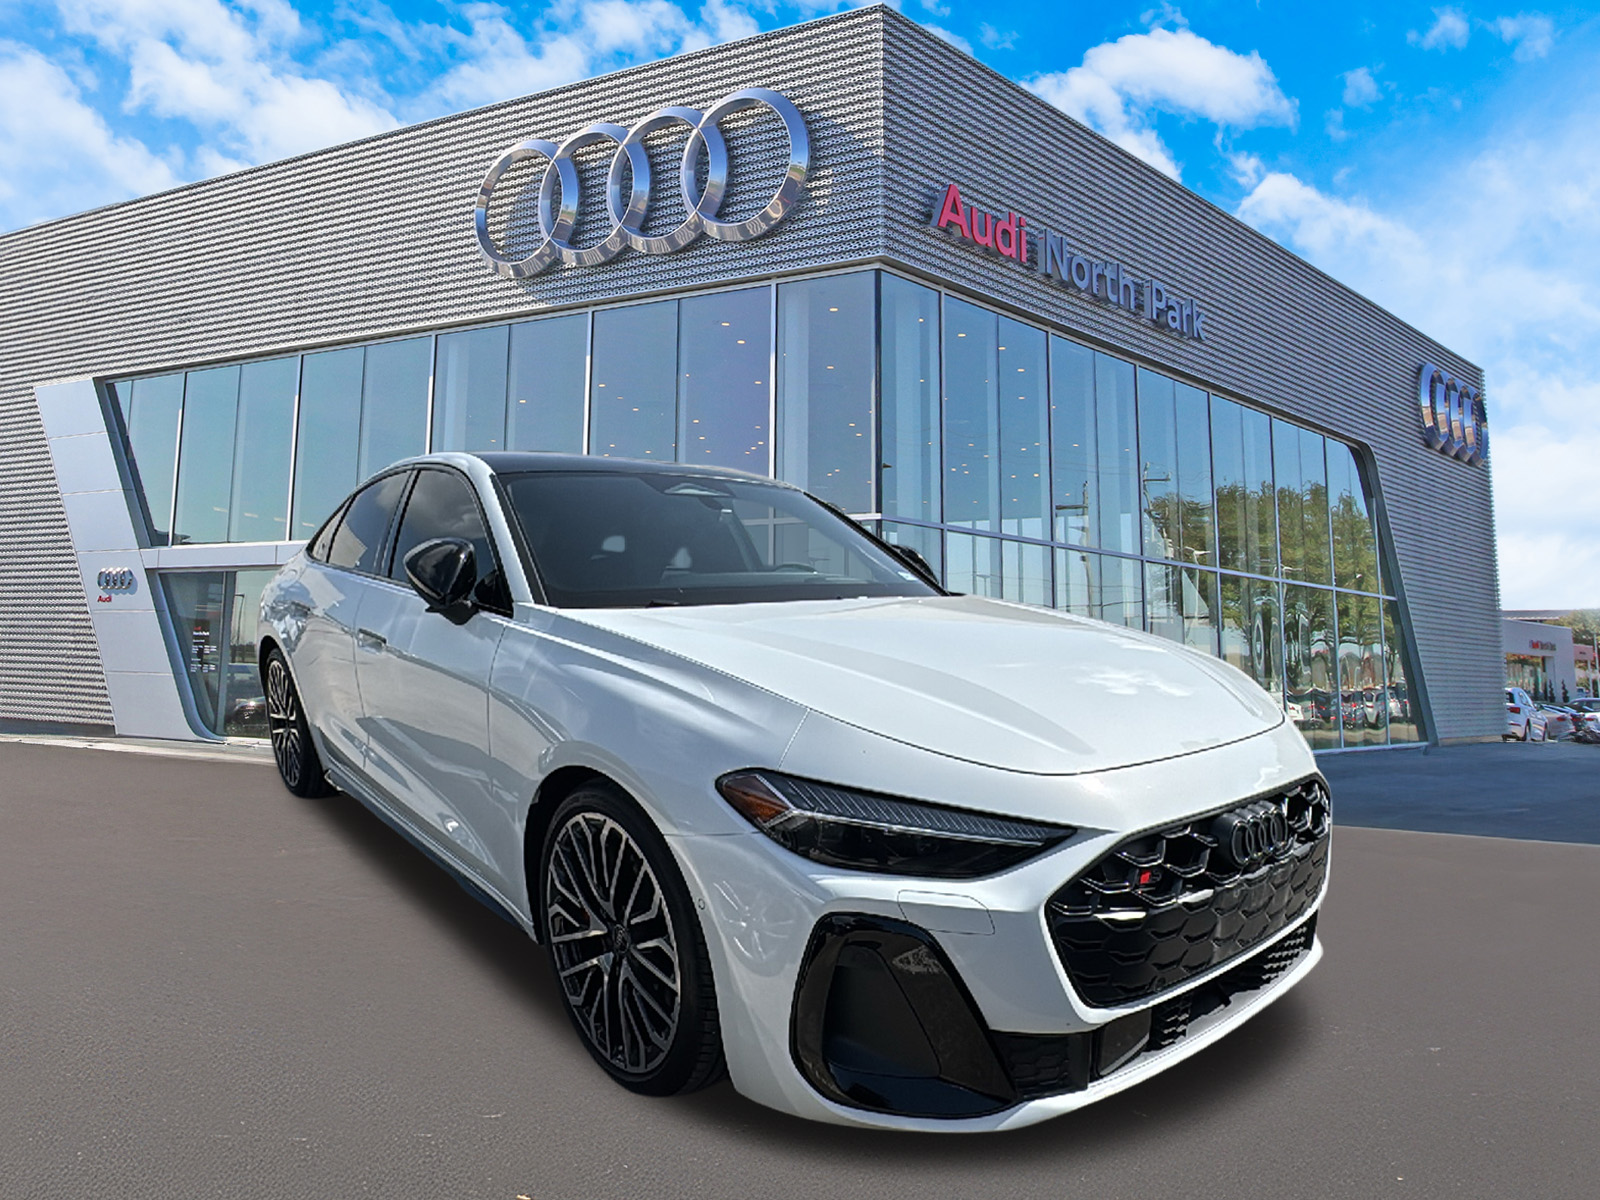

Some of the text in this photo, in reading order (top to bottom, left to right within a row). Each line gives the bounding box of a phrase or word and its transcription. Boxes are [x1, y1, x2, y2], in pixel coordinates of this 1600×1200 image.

[931, 184, 1206, 341] Audi North Park
